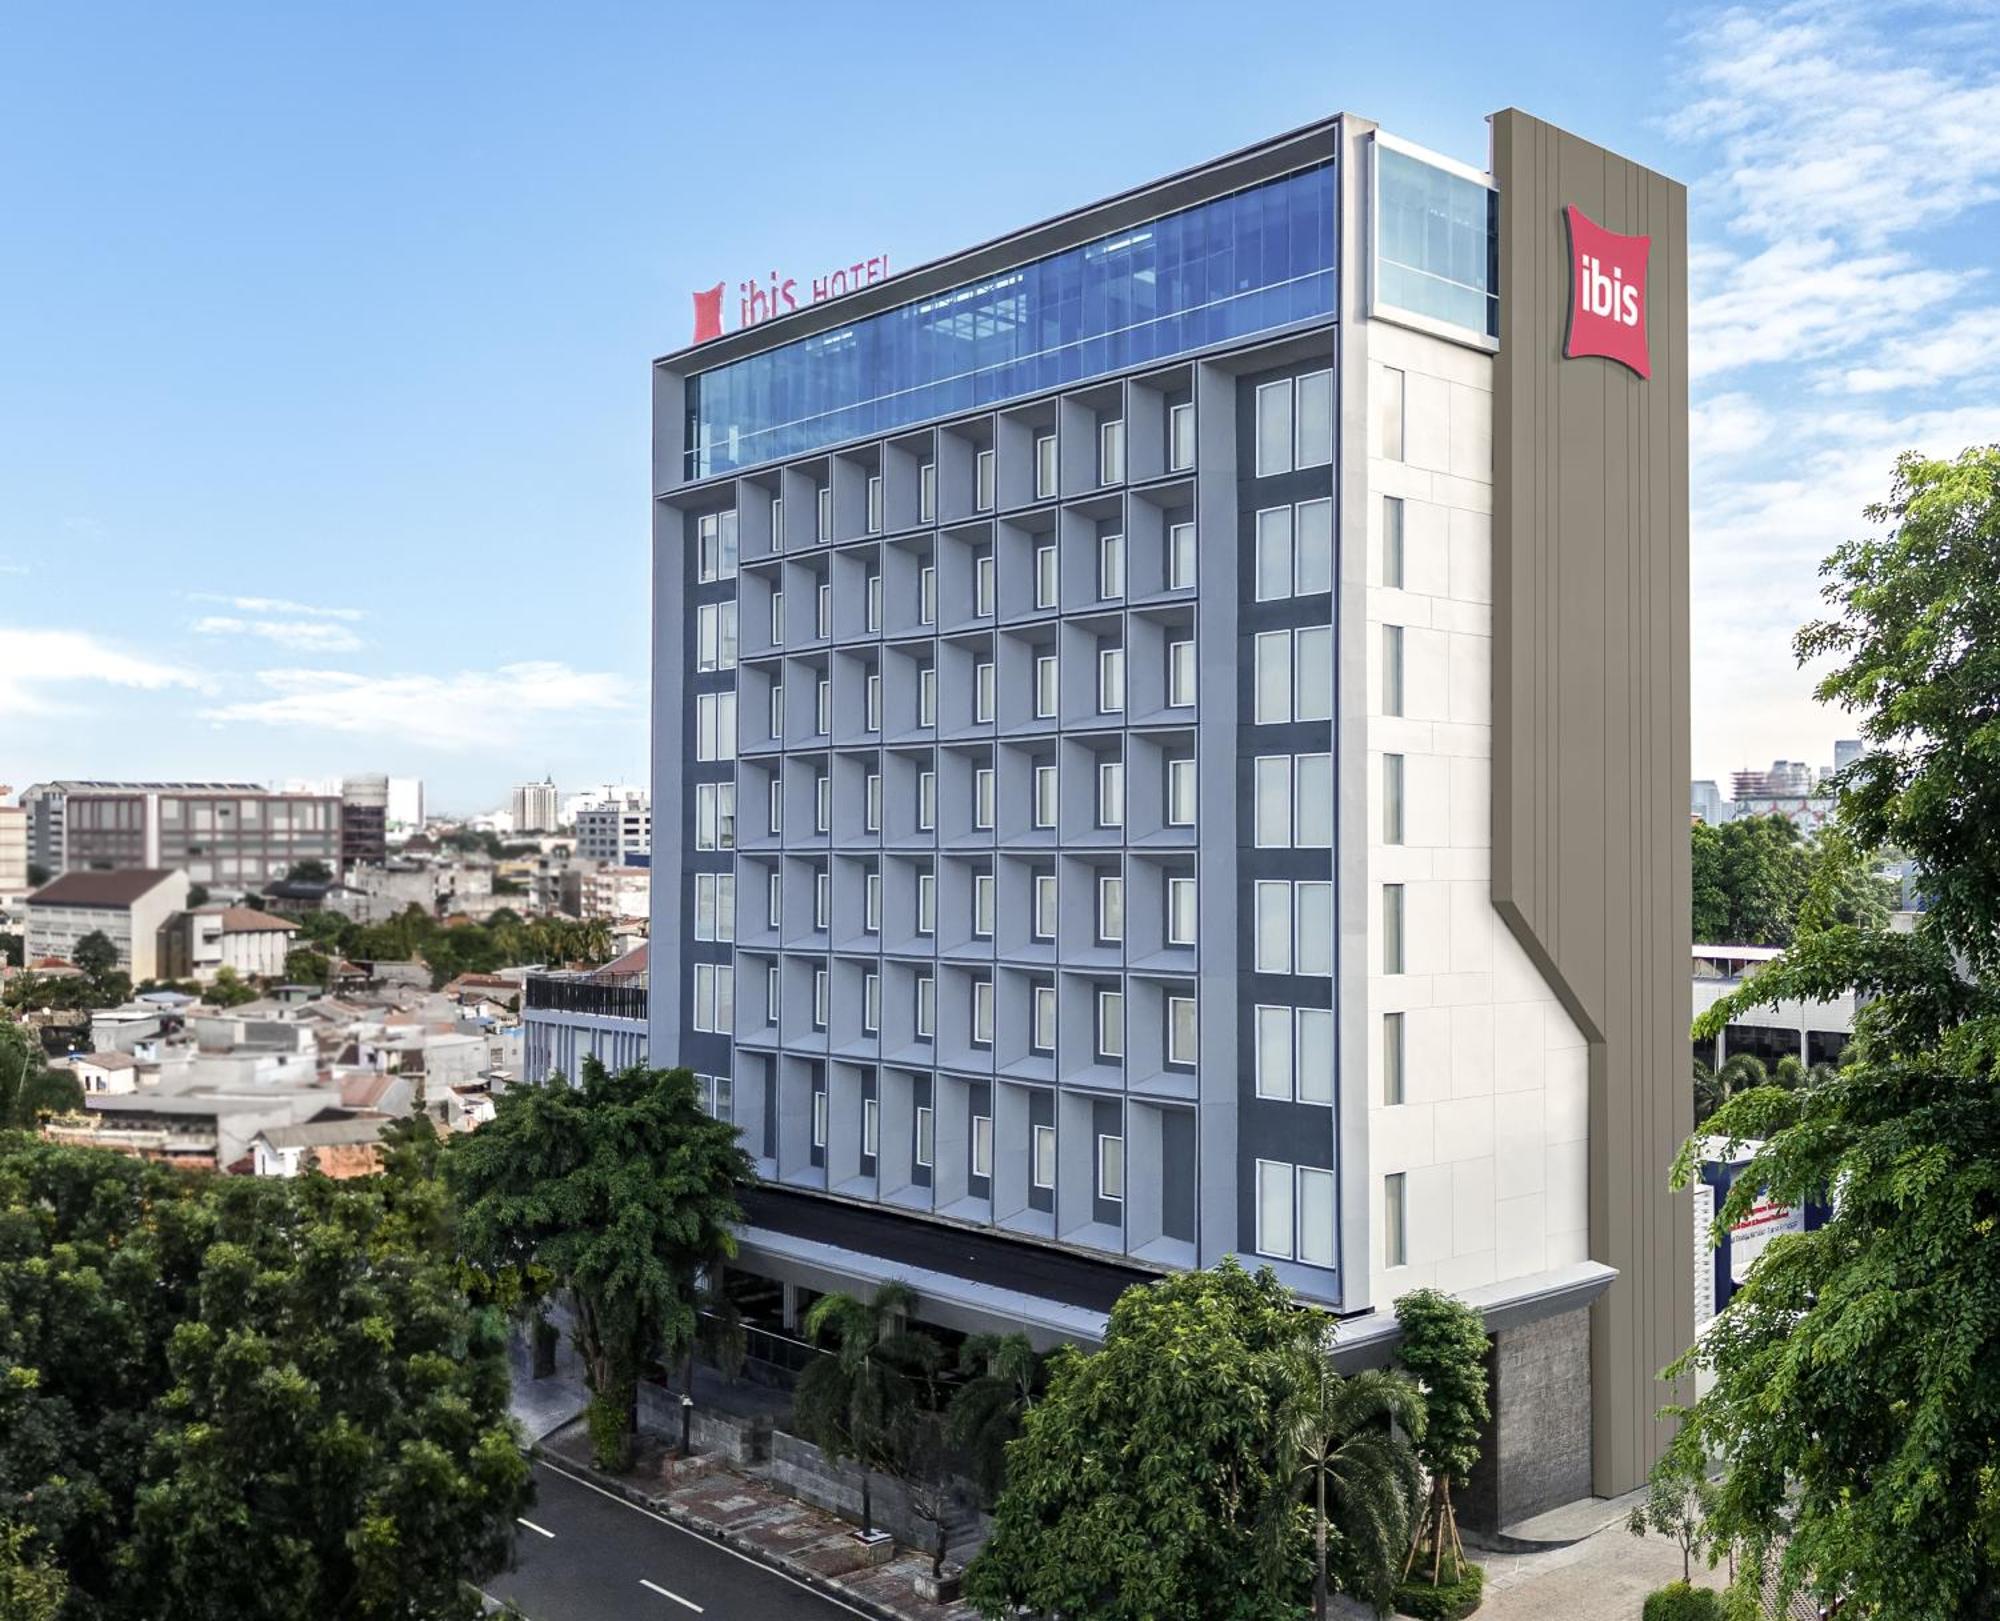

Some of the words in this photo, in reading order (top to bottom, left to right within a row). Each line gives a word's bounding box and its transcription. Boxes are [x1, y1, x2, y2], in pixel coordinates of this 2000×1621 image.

[740, 270, 797, 328] ibis
[813, 254, 888, 302] HOTEL
[1582, 254, 1639, 327] ibis
